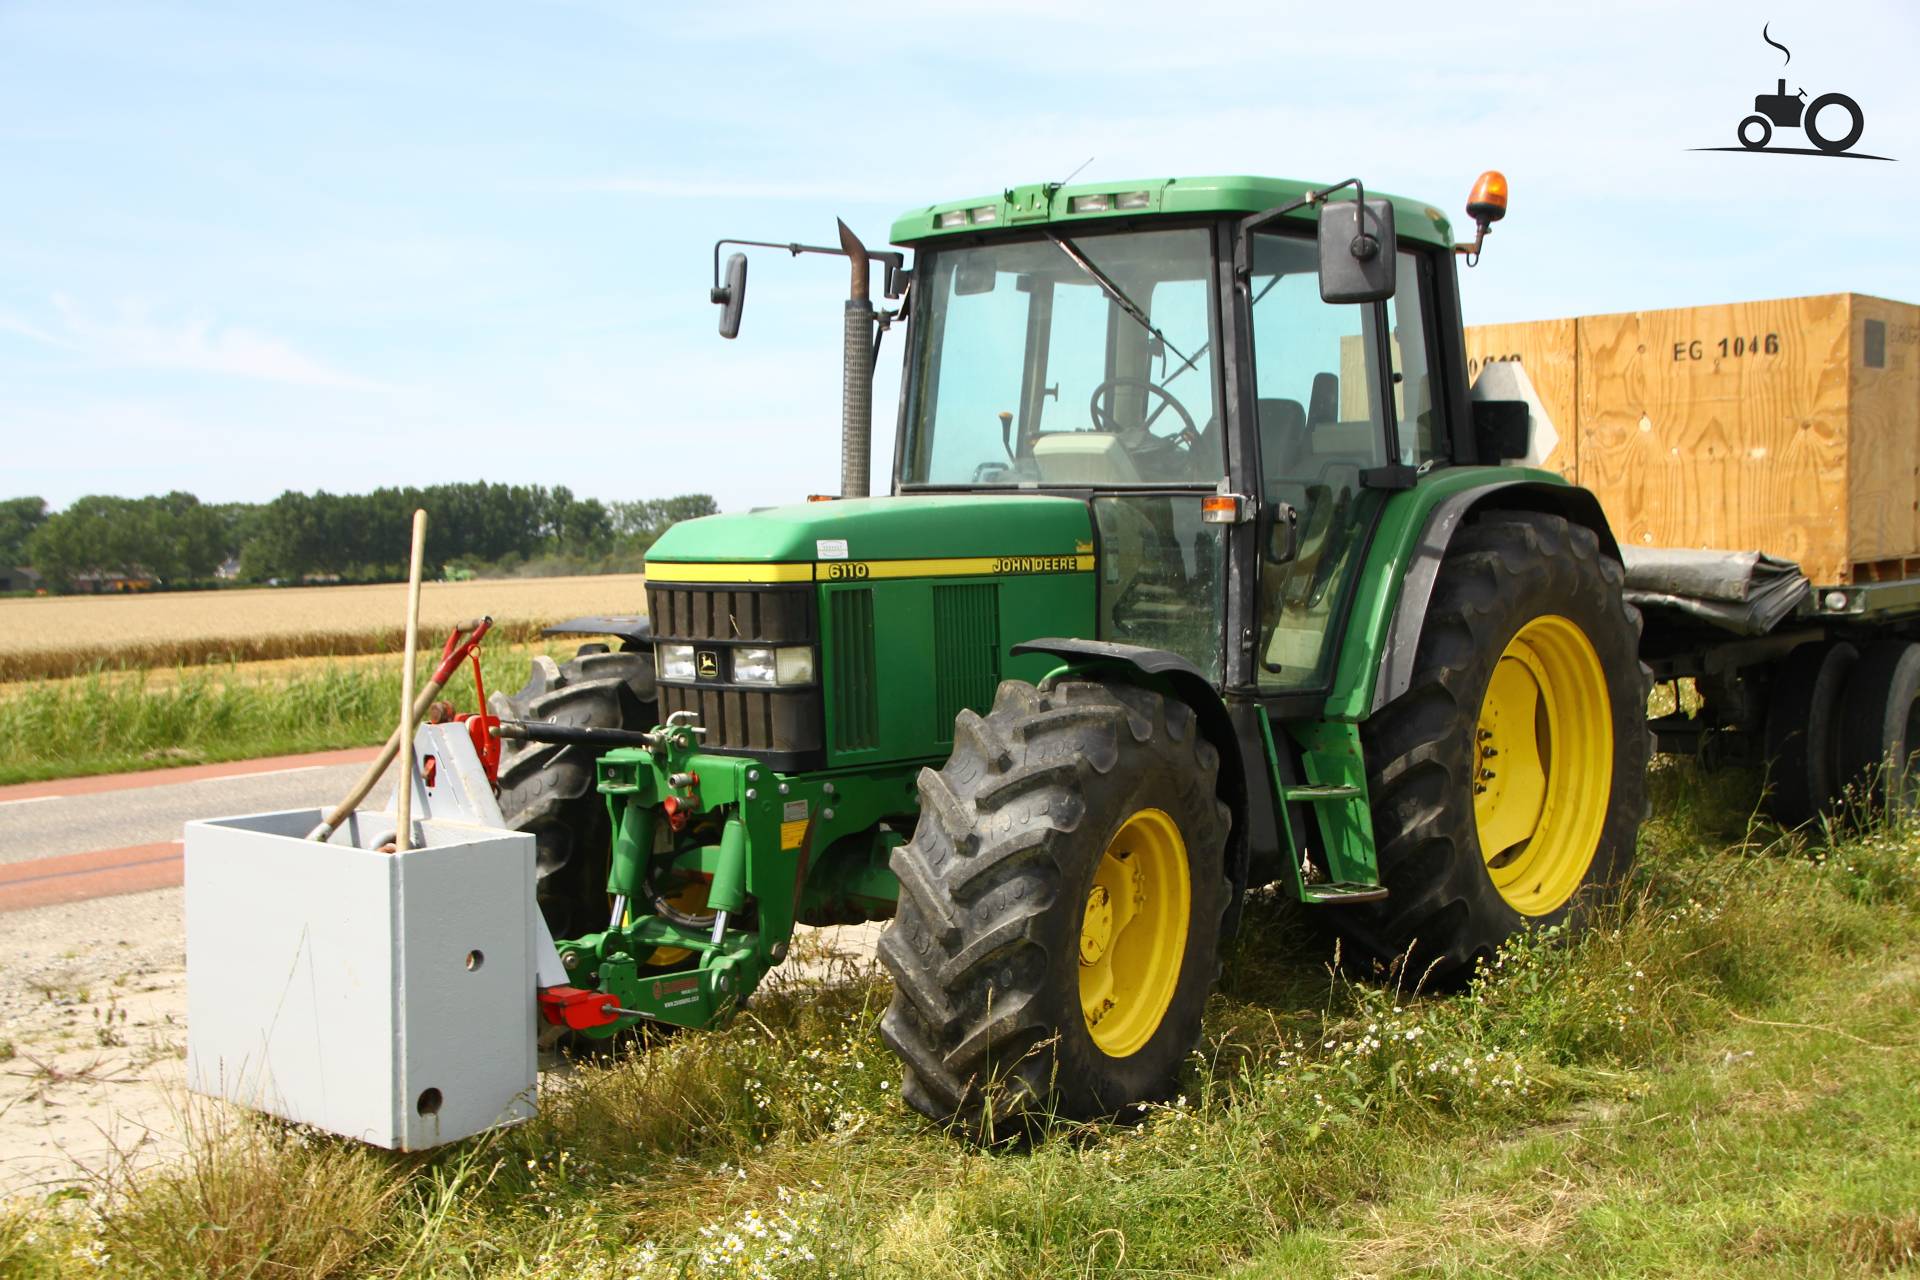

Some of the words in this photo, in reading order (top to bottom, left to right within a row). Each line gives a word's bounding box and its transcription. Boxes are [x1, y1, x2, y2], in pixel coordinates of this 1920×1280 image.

[1673, 340, 1703, 362] EG
[1717, 333, 1779, 358] 1046
[829, 563, 869, 579] 6110
[992, 557, 1031, 574] JOHN
[1034, 556, 1077, 572] DEERE
